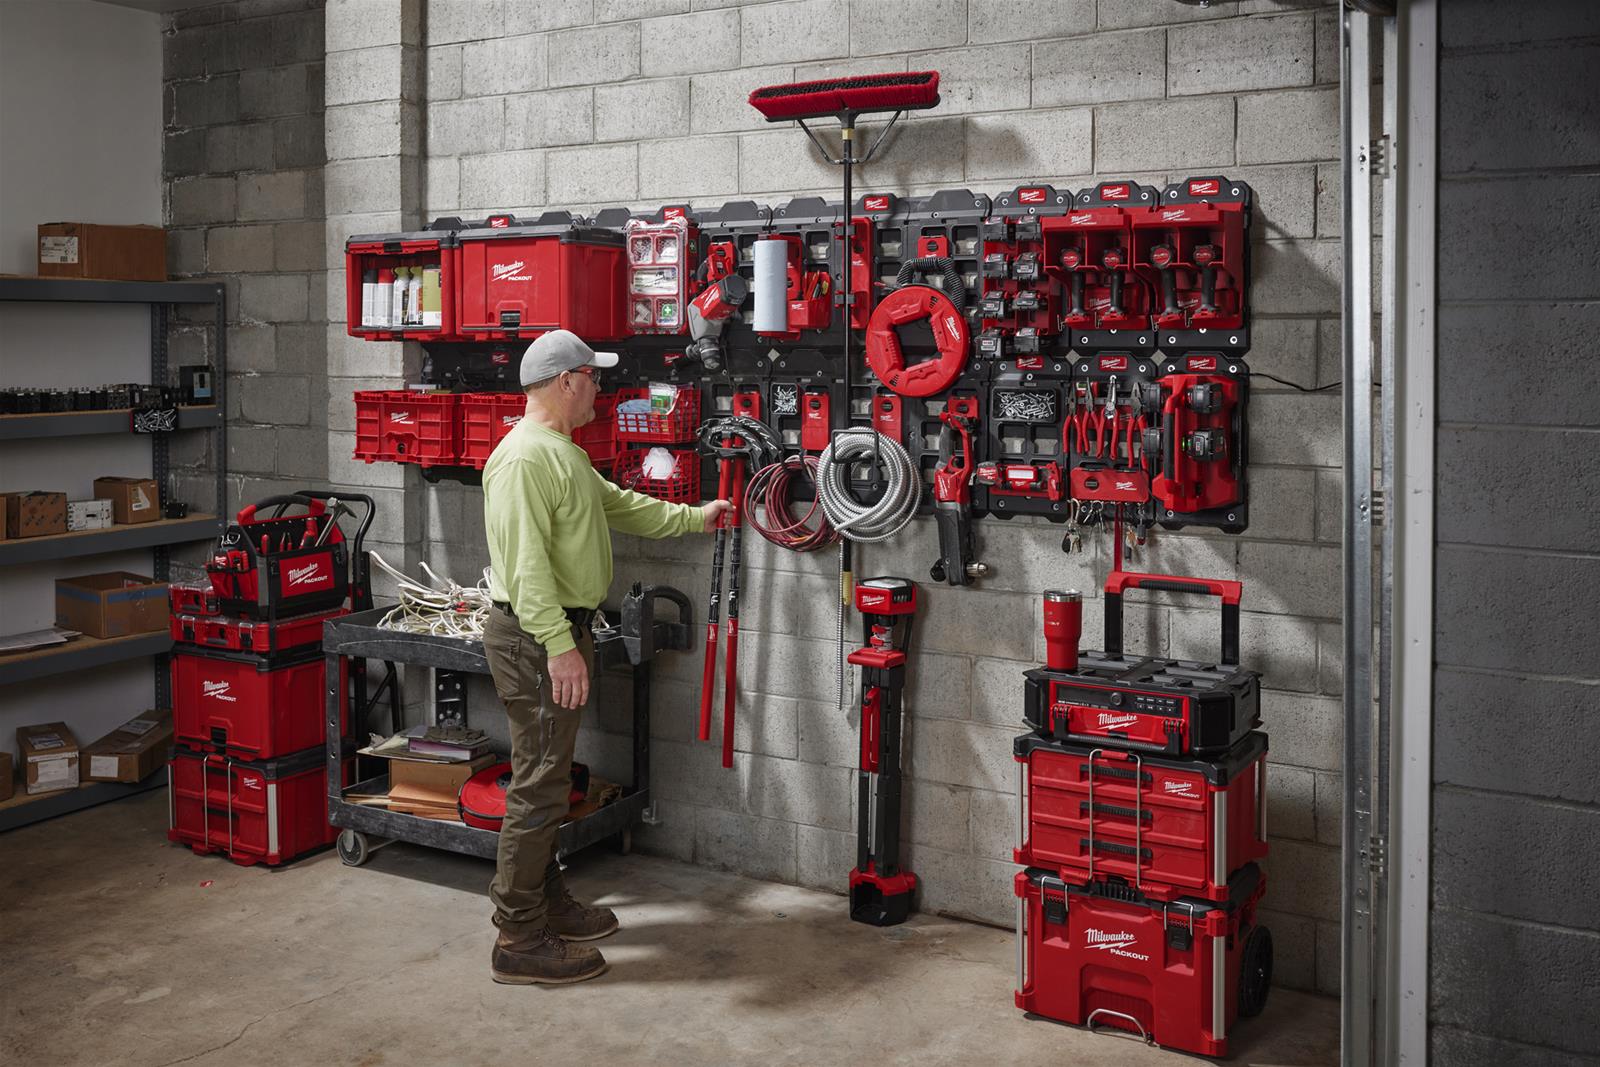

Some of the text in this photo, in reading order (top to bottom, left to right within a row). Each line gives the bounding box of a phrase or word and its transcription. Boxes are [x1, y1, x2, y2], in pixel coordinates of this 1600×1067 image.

[492, 260, 524, 276] Milwaukee
[287, 562, 318, 581] Milwaukee
[304, 575, 328, 584] PACKOUT
[1097, 713, 1136, 724] Milwaukee
[1164, 781, 1192, 790] Milwaukee
[1084, 928, 1135, 943] Milwaukee
[1110, 948, 1149, 961] PACKOUT
